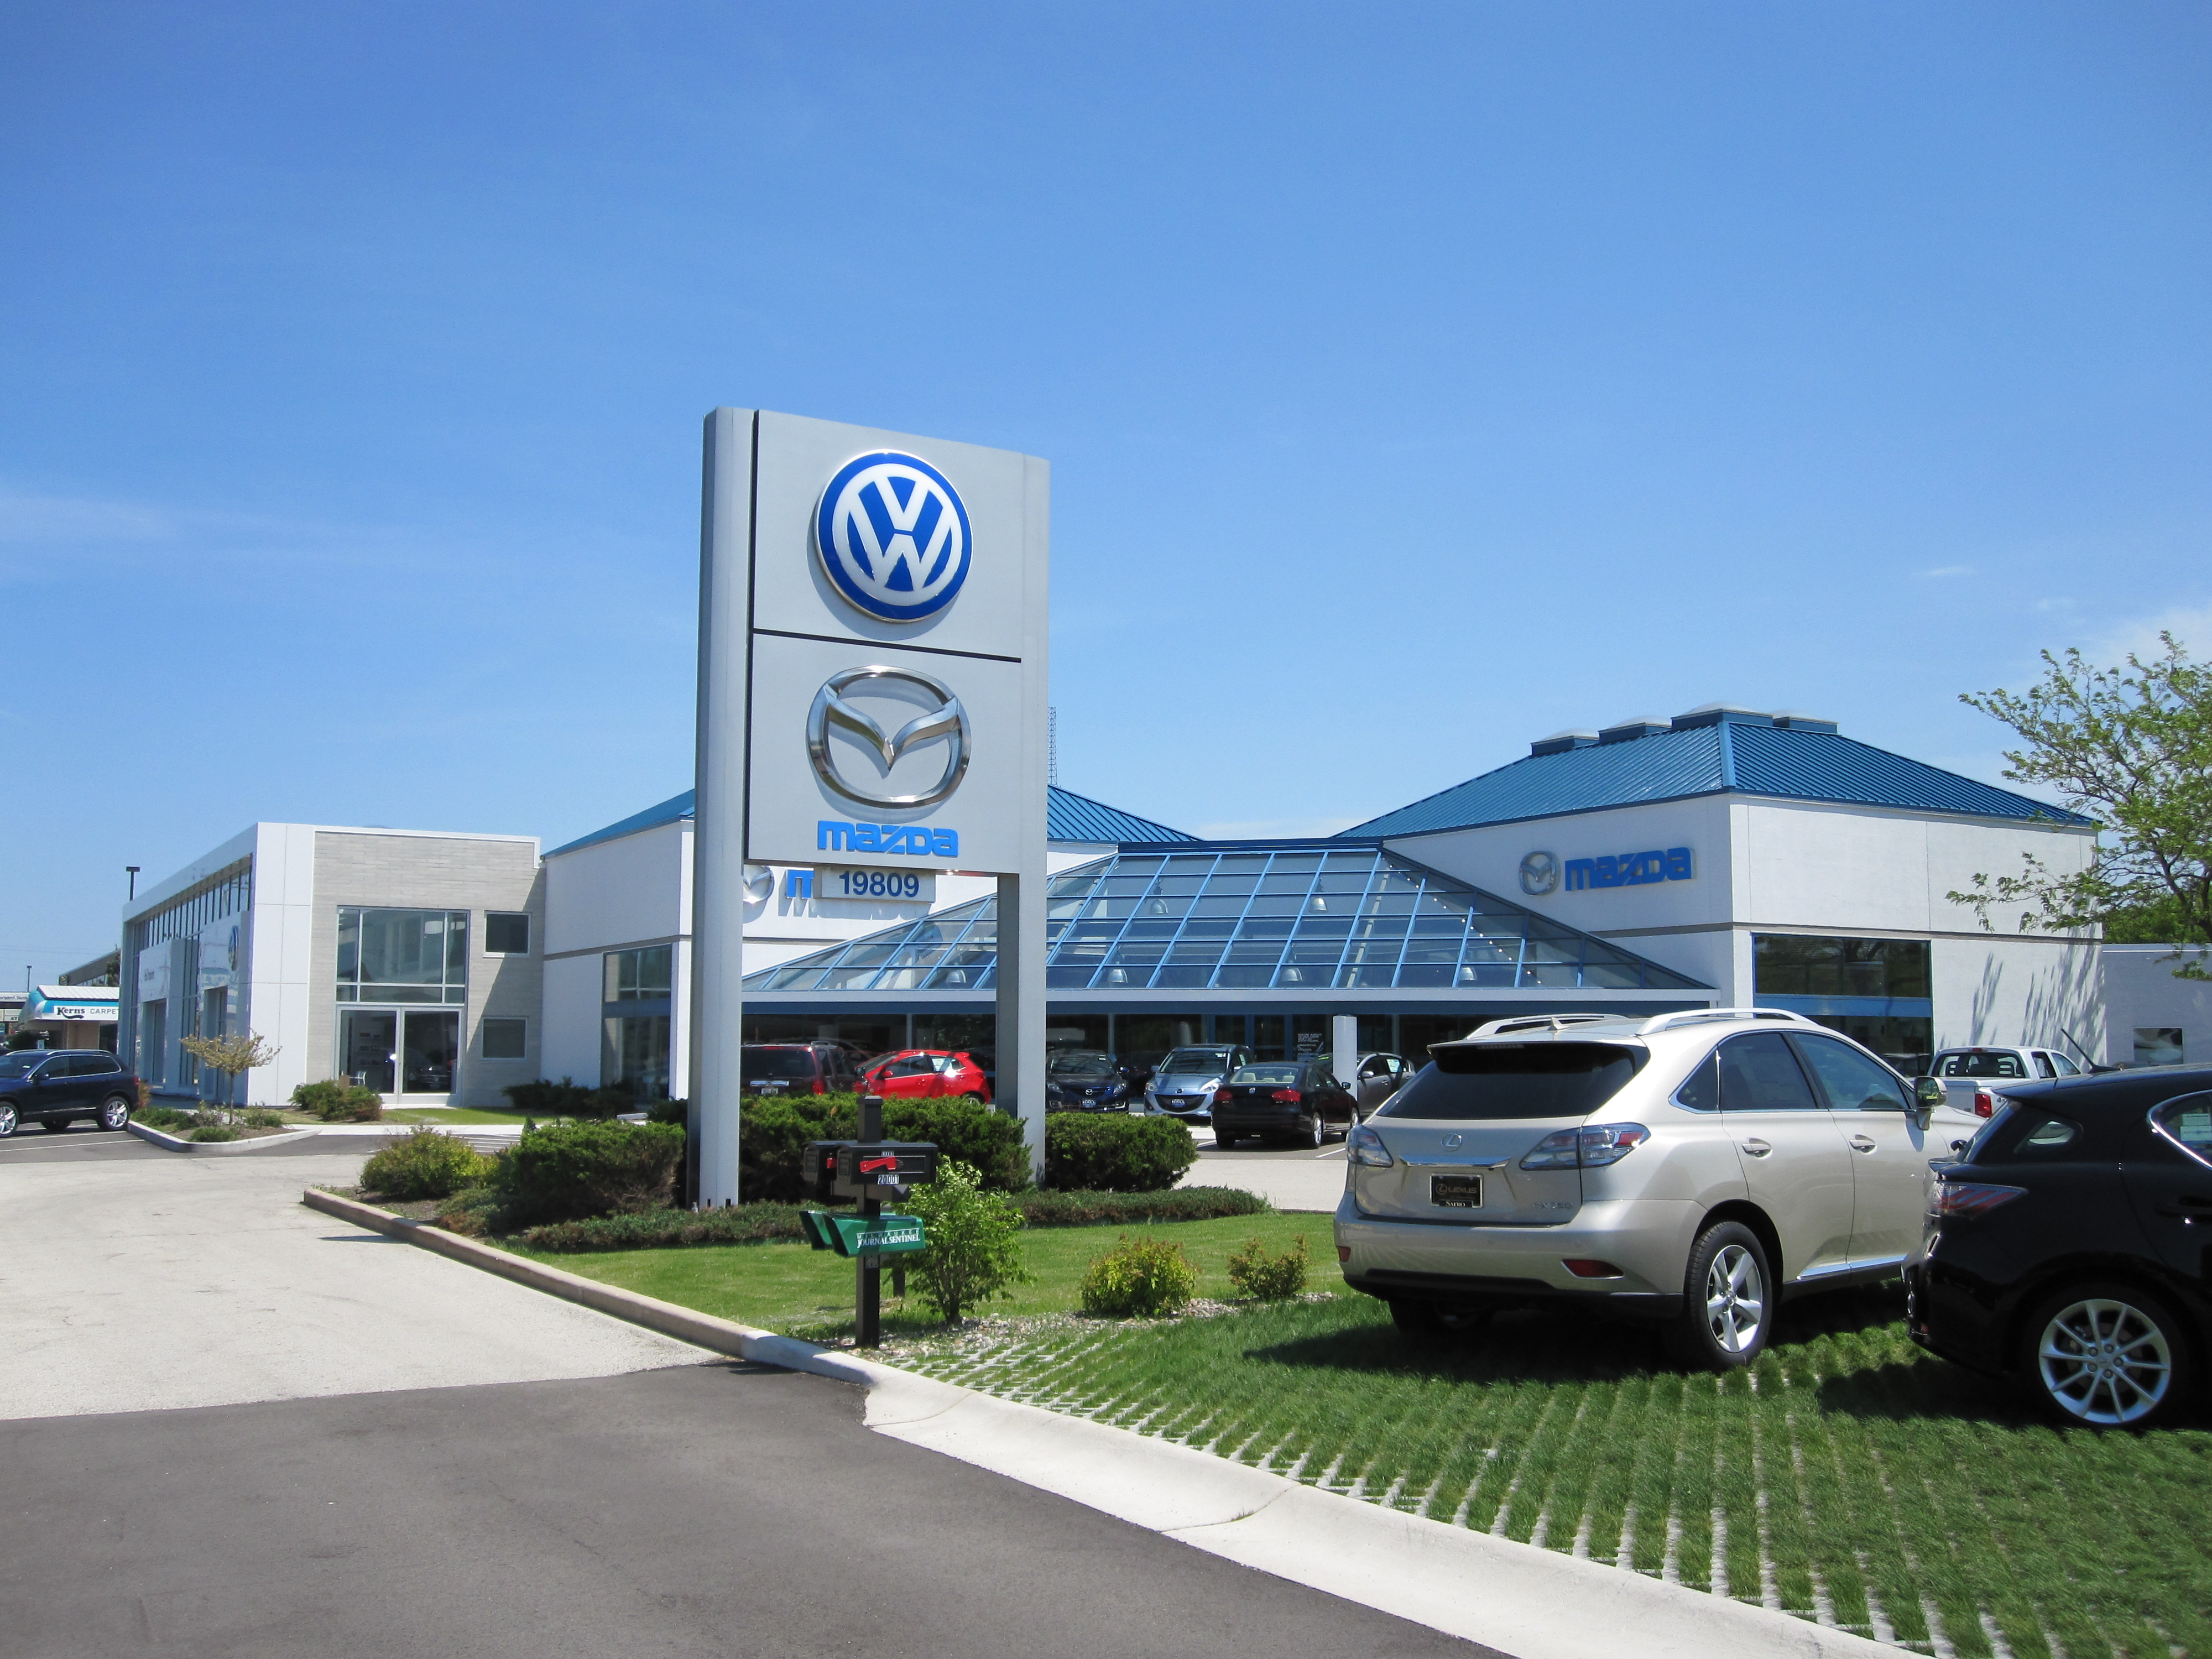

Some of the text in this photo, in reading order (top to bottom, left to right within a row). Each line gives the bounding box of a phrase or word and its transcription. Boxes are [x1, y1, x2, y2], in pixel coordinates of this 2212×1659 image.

[839, 870, 920, 898] 19809
[57, 1007, 86, 1018] Kerns
[857, 1229, 920, 1239] MILWAUKEE
[857, 1234, 921, 1249] JOURNAL SENTINEL
